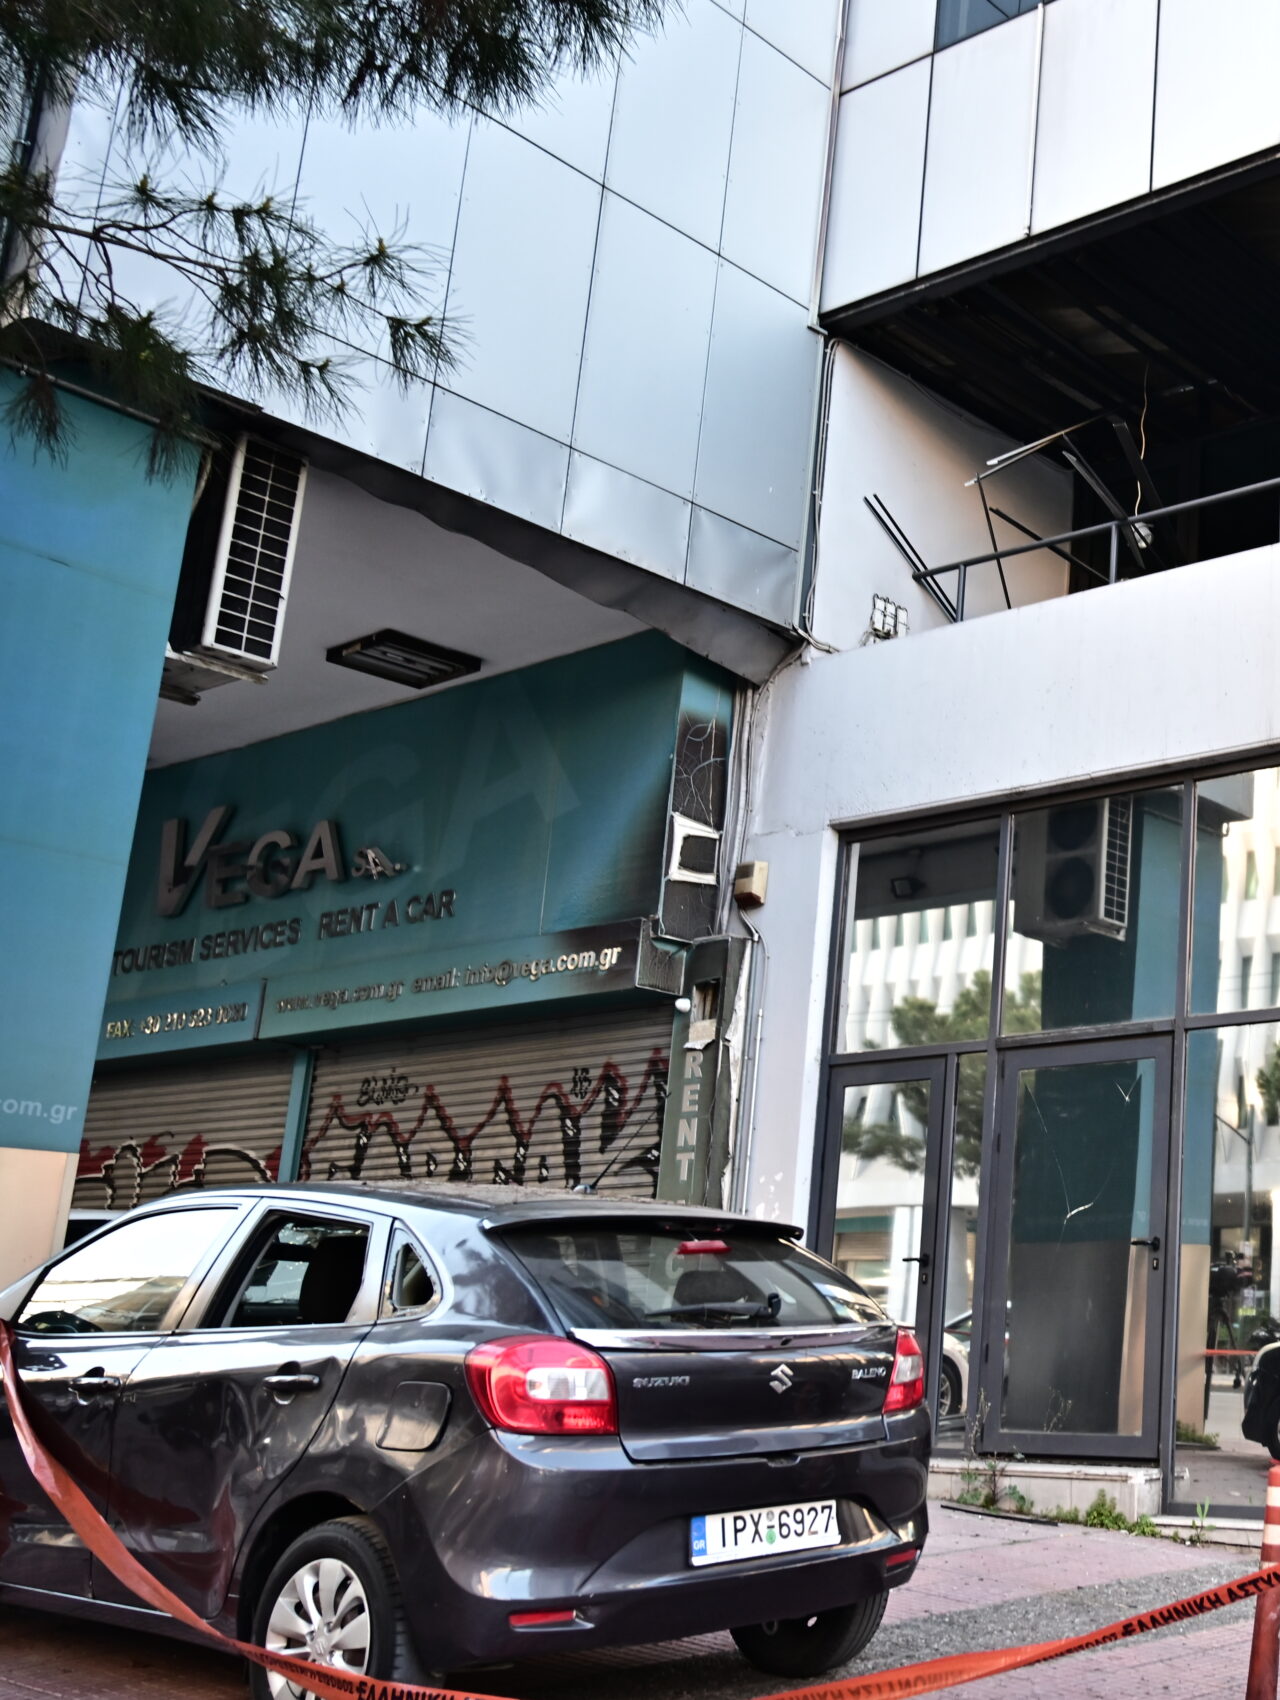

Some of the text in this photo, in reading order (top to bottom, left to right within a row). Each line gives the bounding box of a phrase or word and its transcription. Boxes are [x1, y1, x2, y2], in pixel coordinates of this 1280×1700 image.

[158, 803, 348, 918] VEGA
[113, 889, 457, 977] TOURISM SERVICES RENT A CAR
[411, 967, 460, 993] email:
[464, 946, 623, 987] info@vega.com.gr
[0, 1098, 78, 1124] om.gr
[671, 1049, 705, 1182] RENT
[632, 1375, 691, 1389] SUZUKI
[851, 1366, 887, 1380] BALENO
[693, 1540, 706, 1551] GR
[1122, 1591, 1226, 1637] ΕΛΛΗΝΙΚΗ
